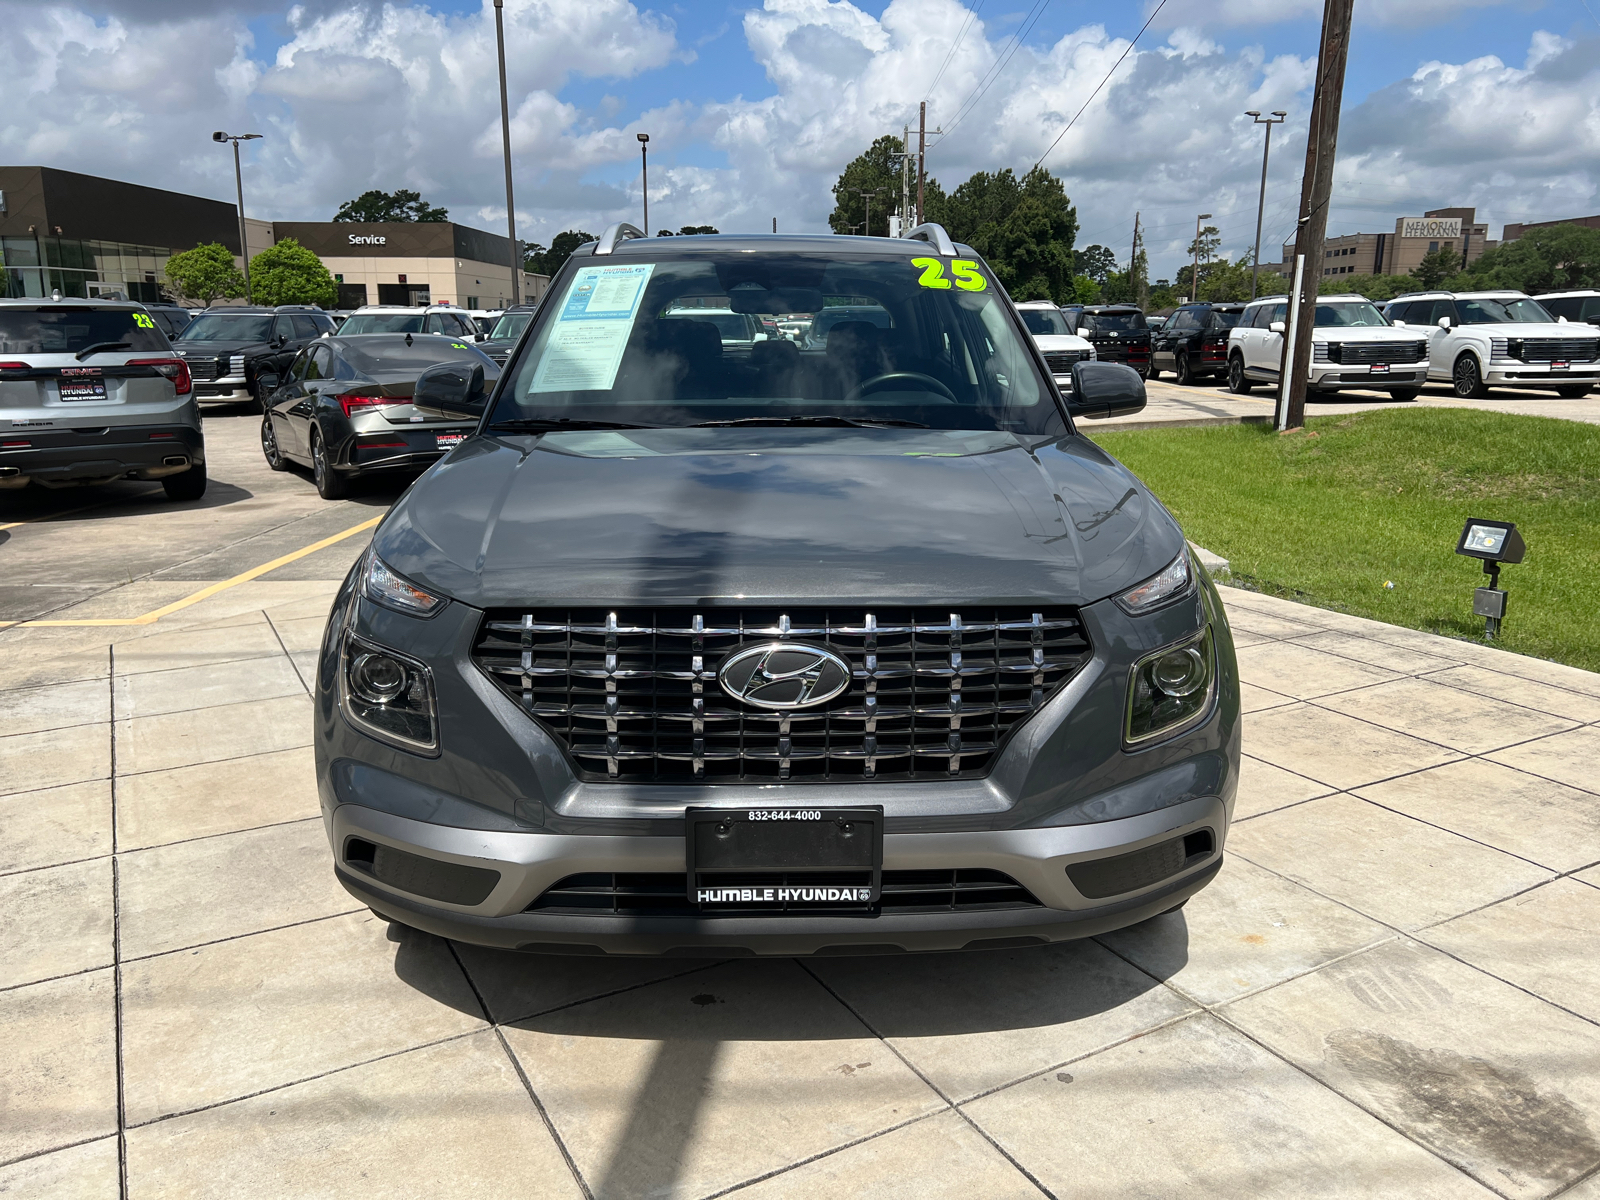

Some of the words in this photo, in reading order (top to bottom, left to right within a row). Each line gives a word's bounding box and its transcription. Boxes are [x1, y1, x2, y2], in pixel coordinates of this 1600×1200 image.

[1405, 221, 1459, 230] MEMORIAL
[1404, 228, 1458, 237] HERMANN
[348, 234, 386, 245] Service
[910, 257, 988, 292] 25
[132, 313, 154, 329] 23
[60, 367, 102, 377] GMC
[748, 811, 821, 821] 832-644-4000
[697, 889, 774, 902] HUMBLE
[778, 889, 857, 901] HYUNDAI
